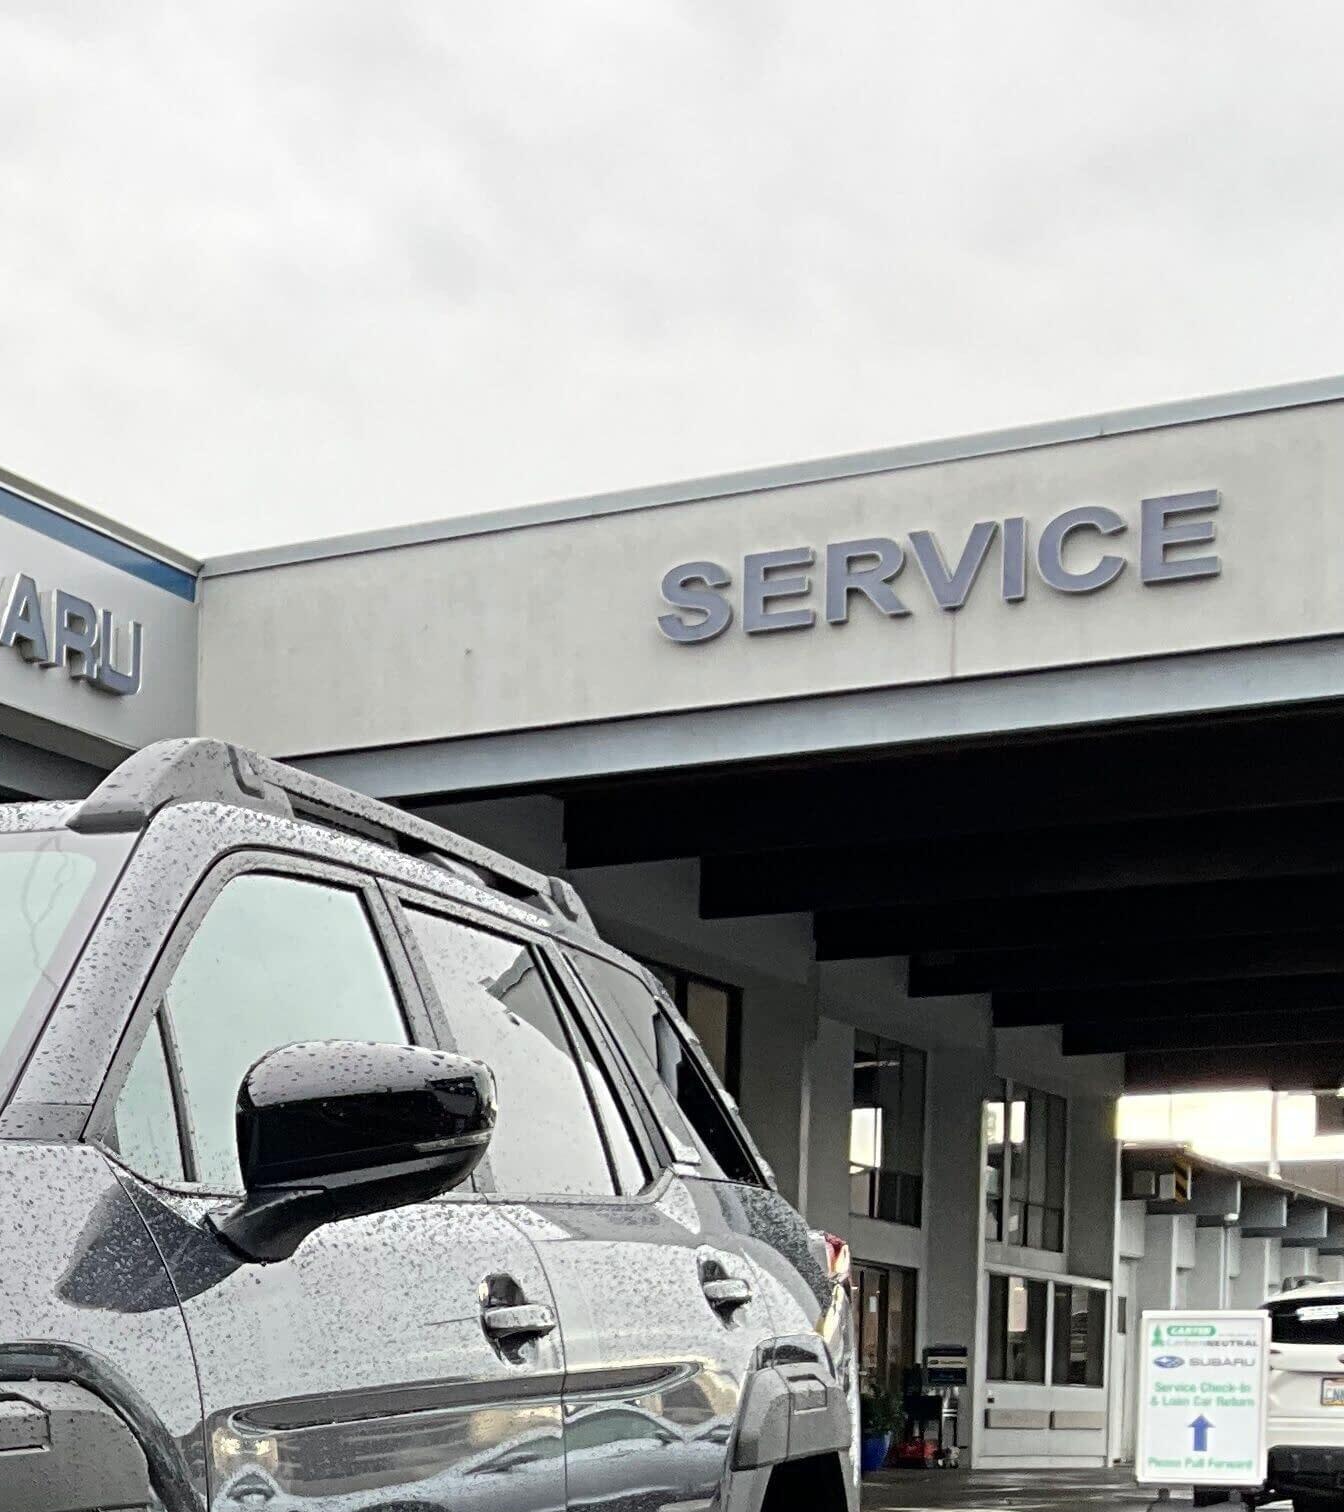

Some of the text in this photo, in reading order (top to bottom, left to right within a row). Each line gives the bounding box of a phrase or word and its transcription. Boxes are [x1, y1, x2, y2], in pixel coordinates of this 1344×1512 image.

[657, 488, 1222, 645] SERVICE
[1189, 1357, 1256, 1367] SUBARU
[1154, 1381, 1197, 1393] Service
[1193, 1395, 1213, 1407] Car
[1216, 1395, 1255, 1407] Return
